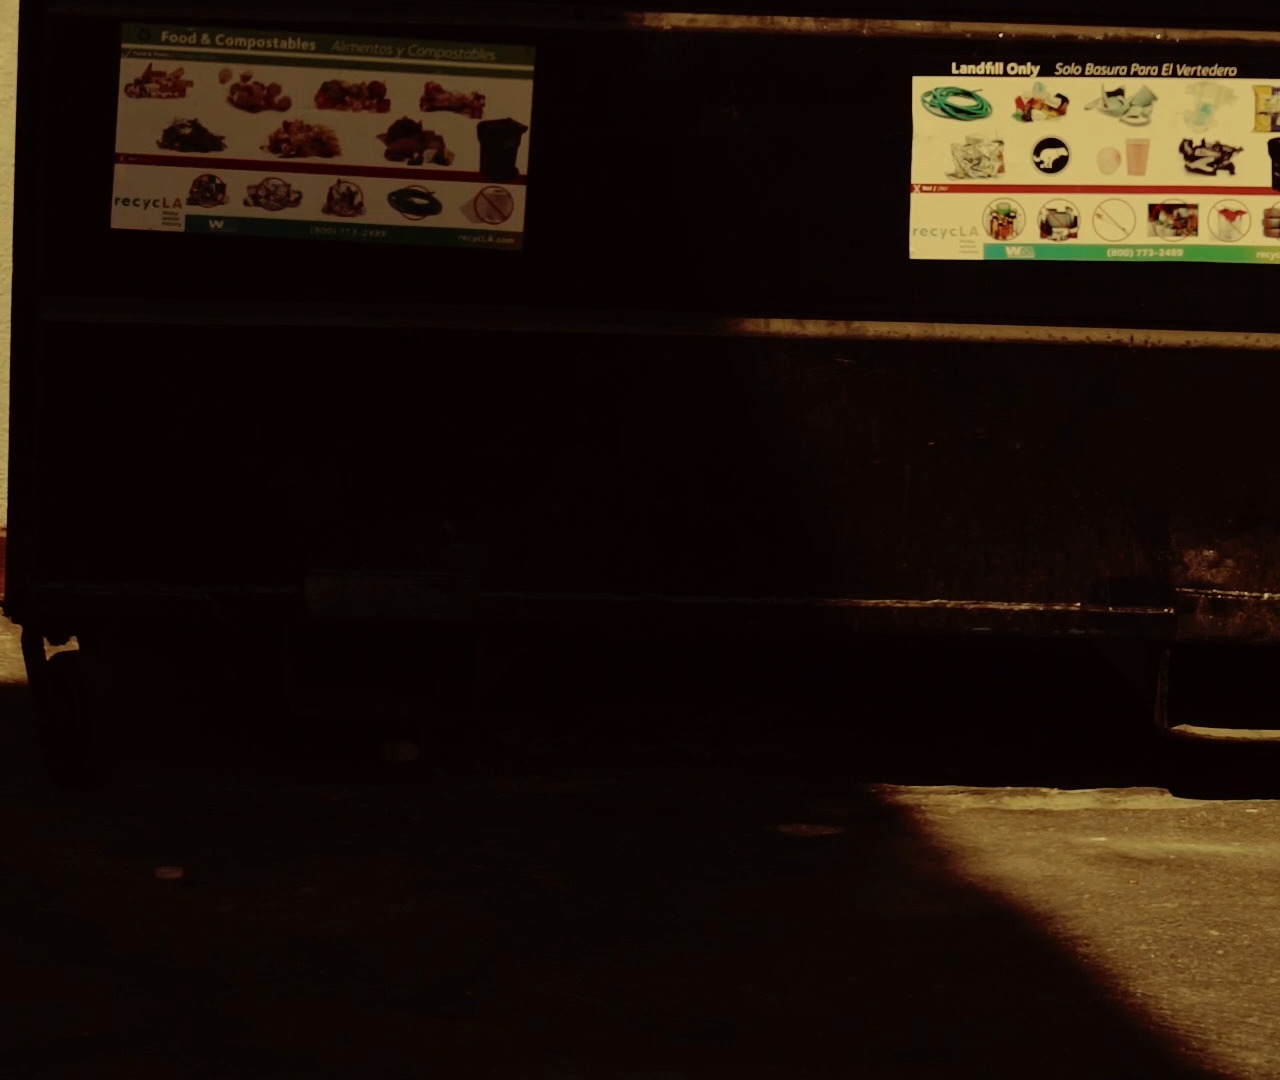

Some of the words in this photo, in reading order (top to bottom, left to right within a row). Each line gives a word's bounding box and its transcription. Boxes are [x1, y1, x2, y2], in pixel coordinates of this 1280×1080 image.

[161, 31, 197, 46] Food
[200, 34, 212, 46] &
[214, 34, 317, 52] Compostables
[331, 40, 391, 57] Alimentos
[394, 46, 404, 58] y
[407, 44, 497, 62] Compostables
[951, 61, 1003, 75] Landfill
[1006, 62, 1040, 78] Only
[1054, 62, 1082, 76] Solo
[1085, 62, 1128, 76] Basura
[1131, 63, 1159, 77] Para
[1161, 63, 1172, 77] El
[1175, 64, 1238, 78] Vertedero
[114, 197, 182, 210] recycLA
[913, 224, 979, 241] recycLA
